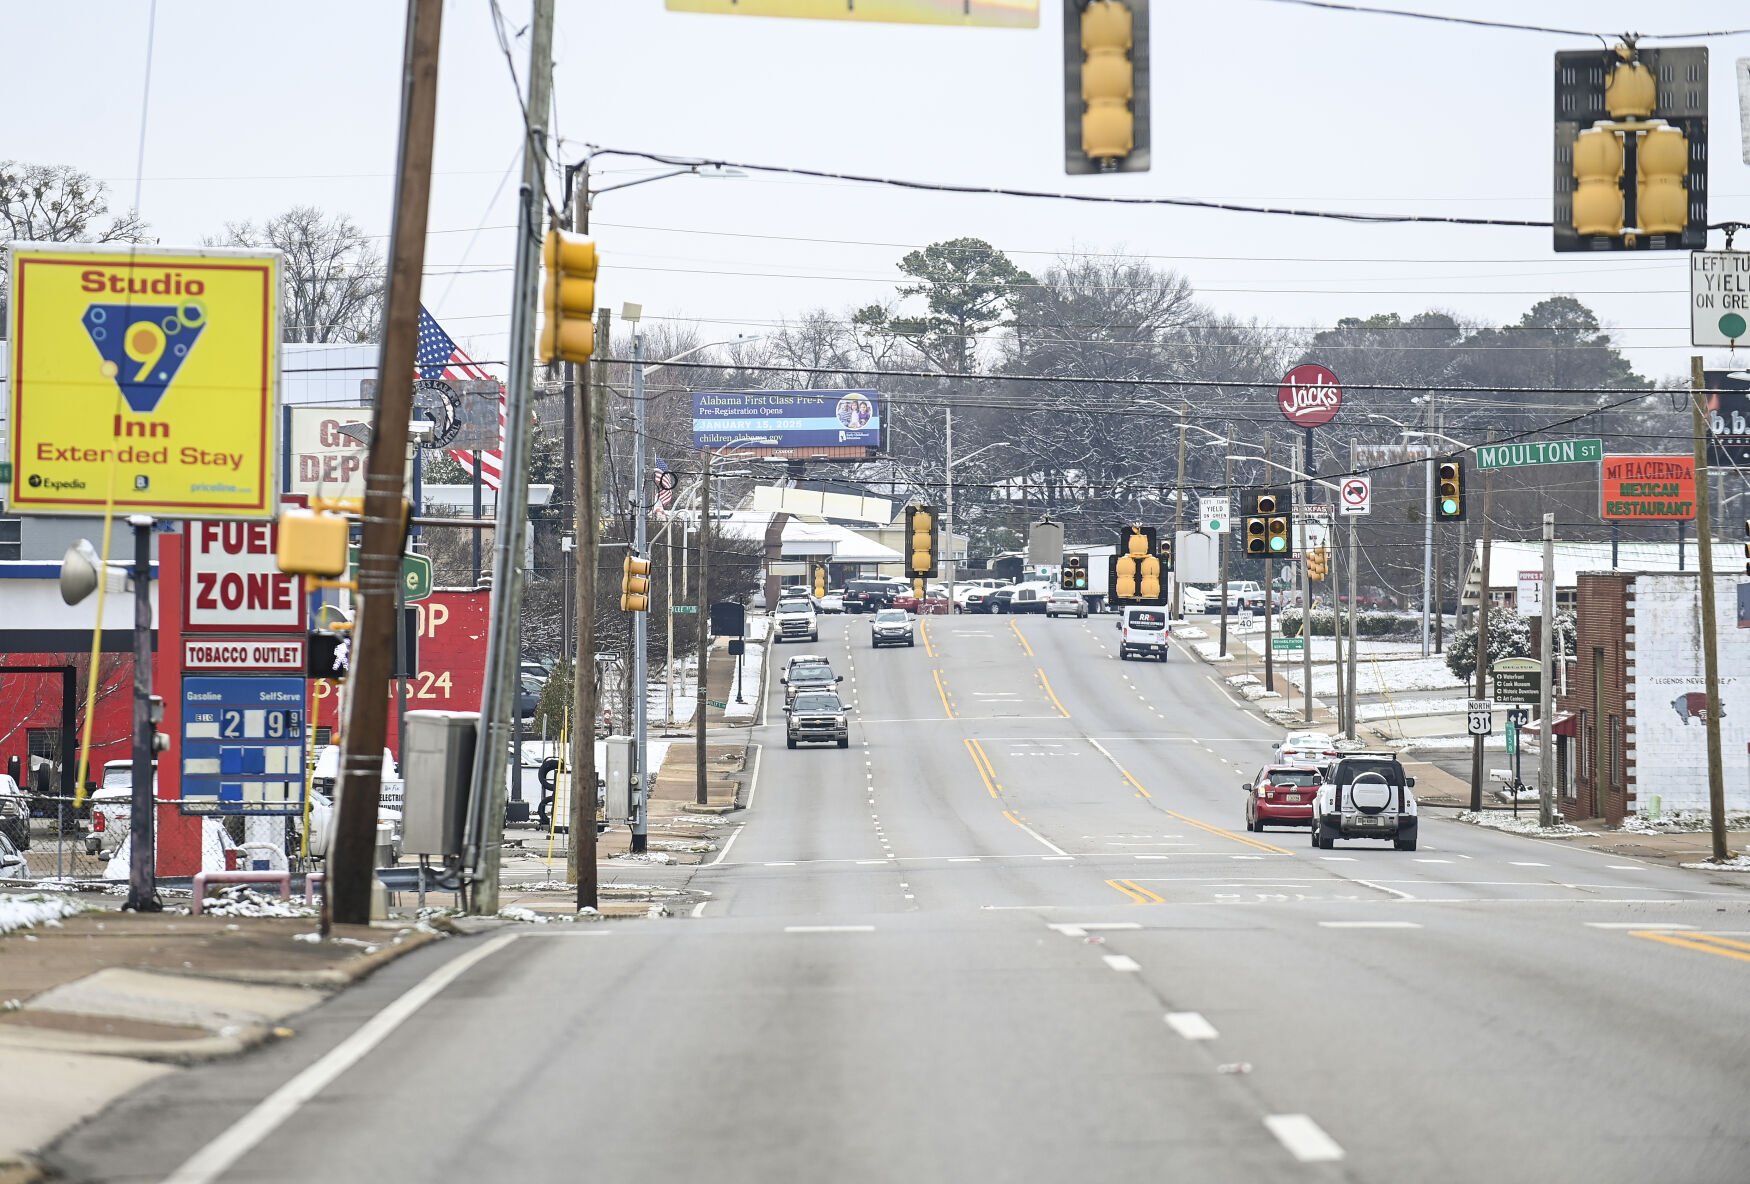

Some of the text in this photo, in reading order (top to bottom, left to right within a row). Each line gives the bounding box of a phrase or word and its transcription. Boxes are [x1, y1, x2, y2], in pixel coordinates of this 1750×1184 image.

[1694, 256, 1750, 272] LEFT TU
[81, 270, 205, 296] Studio
[1705, 274, 1750, 292] YIEL
[1696, 293, 1750, 309] ON GRE
[124, 320, 167, 382] 9
[699, 395, 824, 405] Alabama First Class Pre-K
[699, 407, 783, 416] Pre-Registration Opens
[114, 414, 170, 438] Inn
[699, 421, 751, 429] JANUARY
[776, 420, 802, 428] 2025
[180, 446, 244, 471] Stay
[1482, 441, 1596, 467] MOULTON ST
[300, 454, 370, 483] DEP
[1607, 461, 1693, 480] MI HACIENDA
[43, 477, 86, 490] Expedia
[1620, 482, 1679, 497] MEXICAN
[1606, 500, 1693, 516] RESTAURANT
[196, 572, 292, 610] ZONE
[188, 647, 298, 663] TOBACCO OUTLET
[187, 691, 222, 701] Gasoline
[1469, 702, 1490, 710] NORTH
[224, 711, 283, 738] 2 9
[291, 712, 299, 723] 9
[1473, 717, 1487, 730] 31
[288, 727, 300, 738] 10
